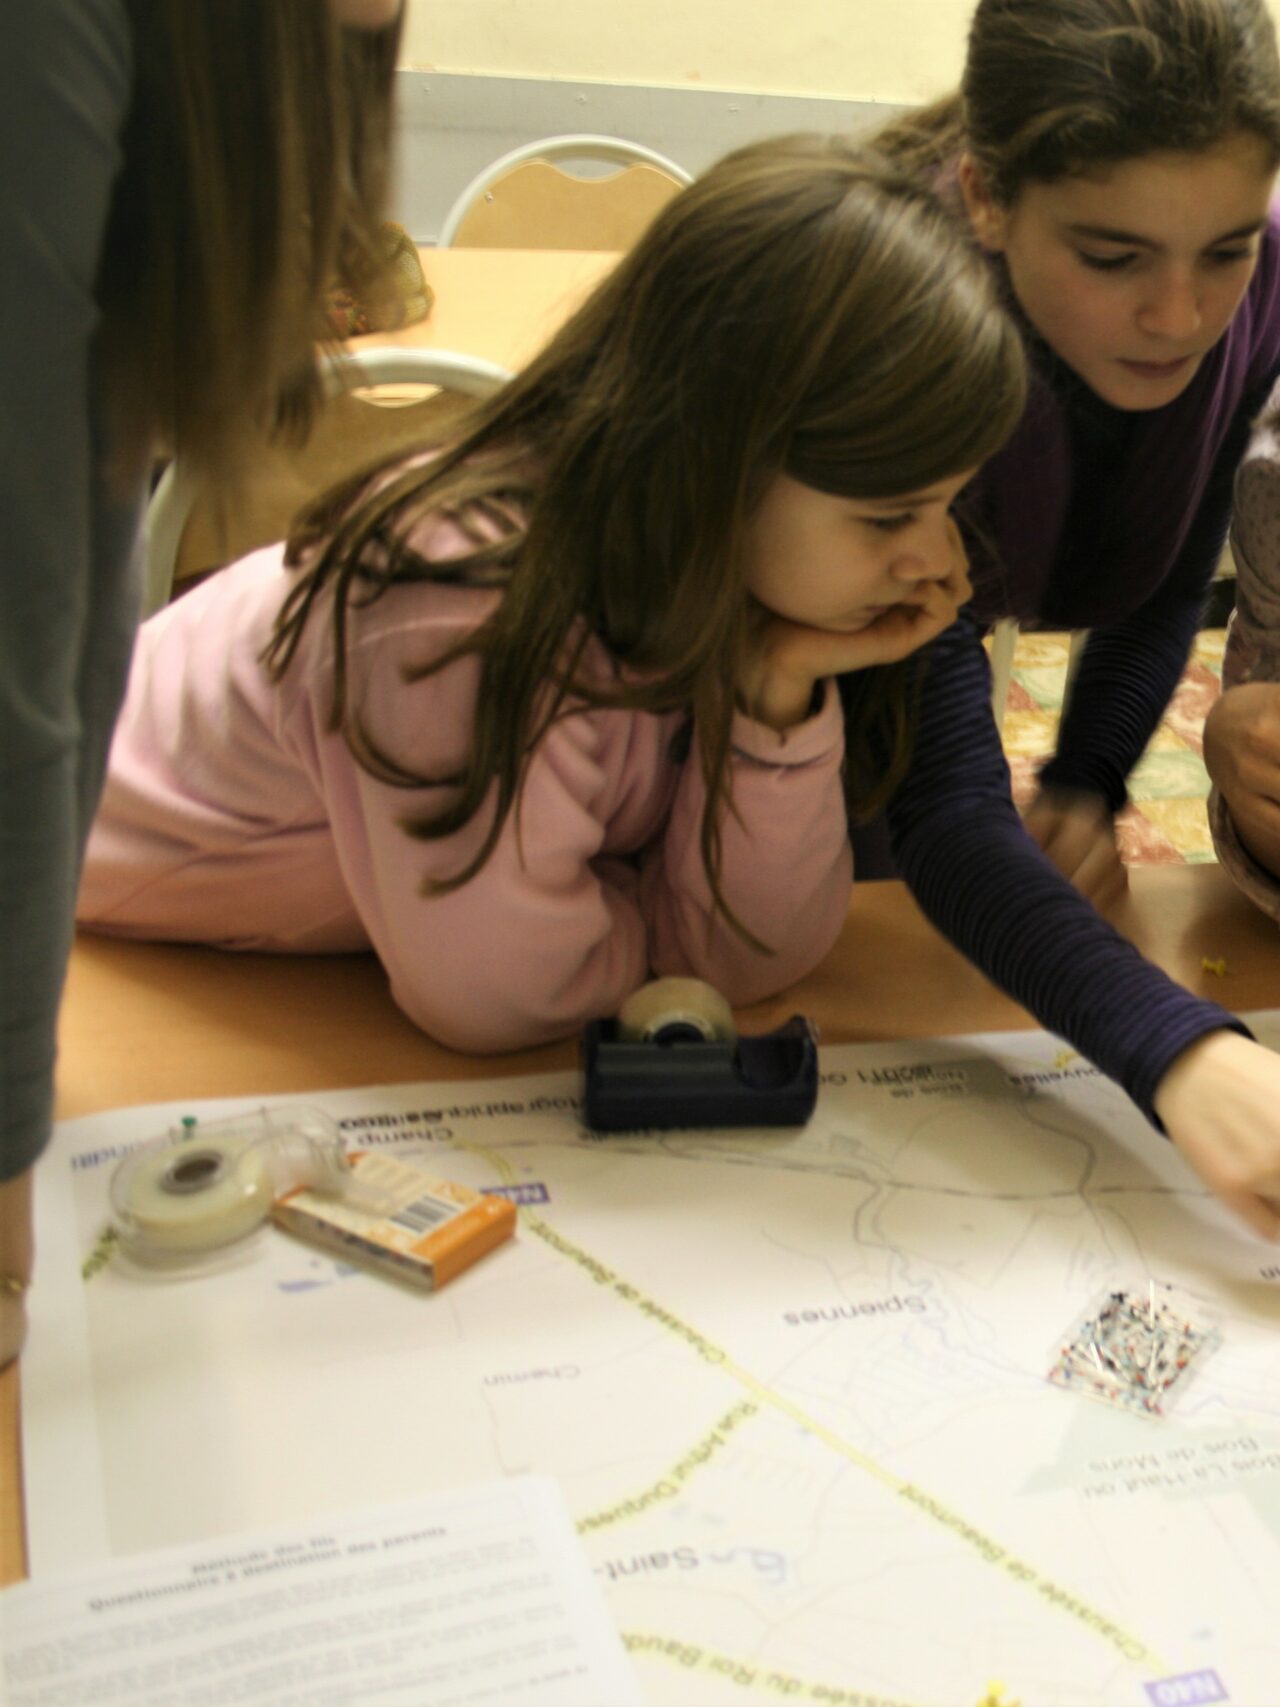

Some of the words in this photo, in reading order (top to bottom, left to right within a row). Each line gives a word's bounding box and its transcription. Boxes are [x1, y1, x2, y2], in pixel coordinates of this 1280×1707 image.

[1008, 1068, 1101, 1087] ouvelles
[447, 1097, 579, 1120] tographiqu
[781, 1294, 928, 1330] Spiennes
[482, 1363, 582, 1391] Chemin
[1123, 1473, 1186, 1494] Haut
[619, 1631, 704, 1669] Baud
[709, 1656, 757, 1687] Roi
[765, 1673, 802, 1695] du
